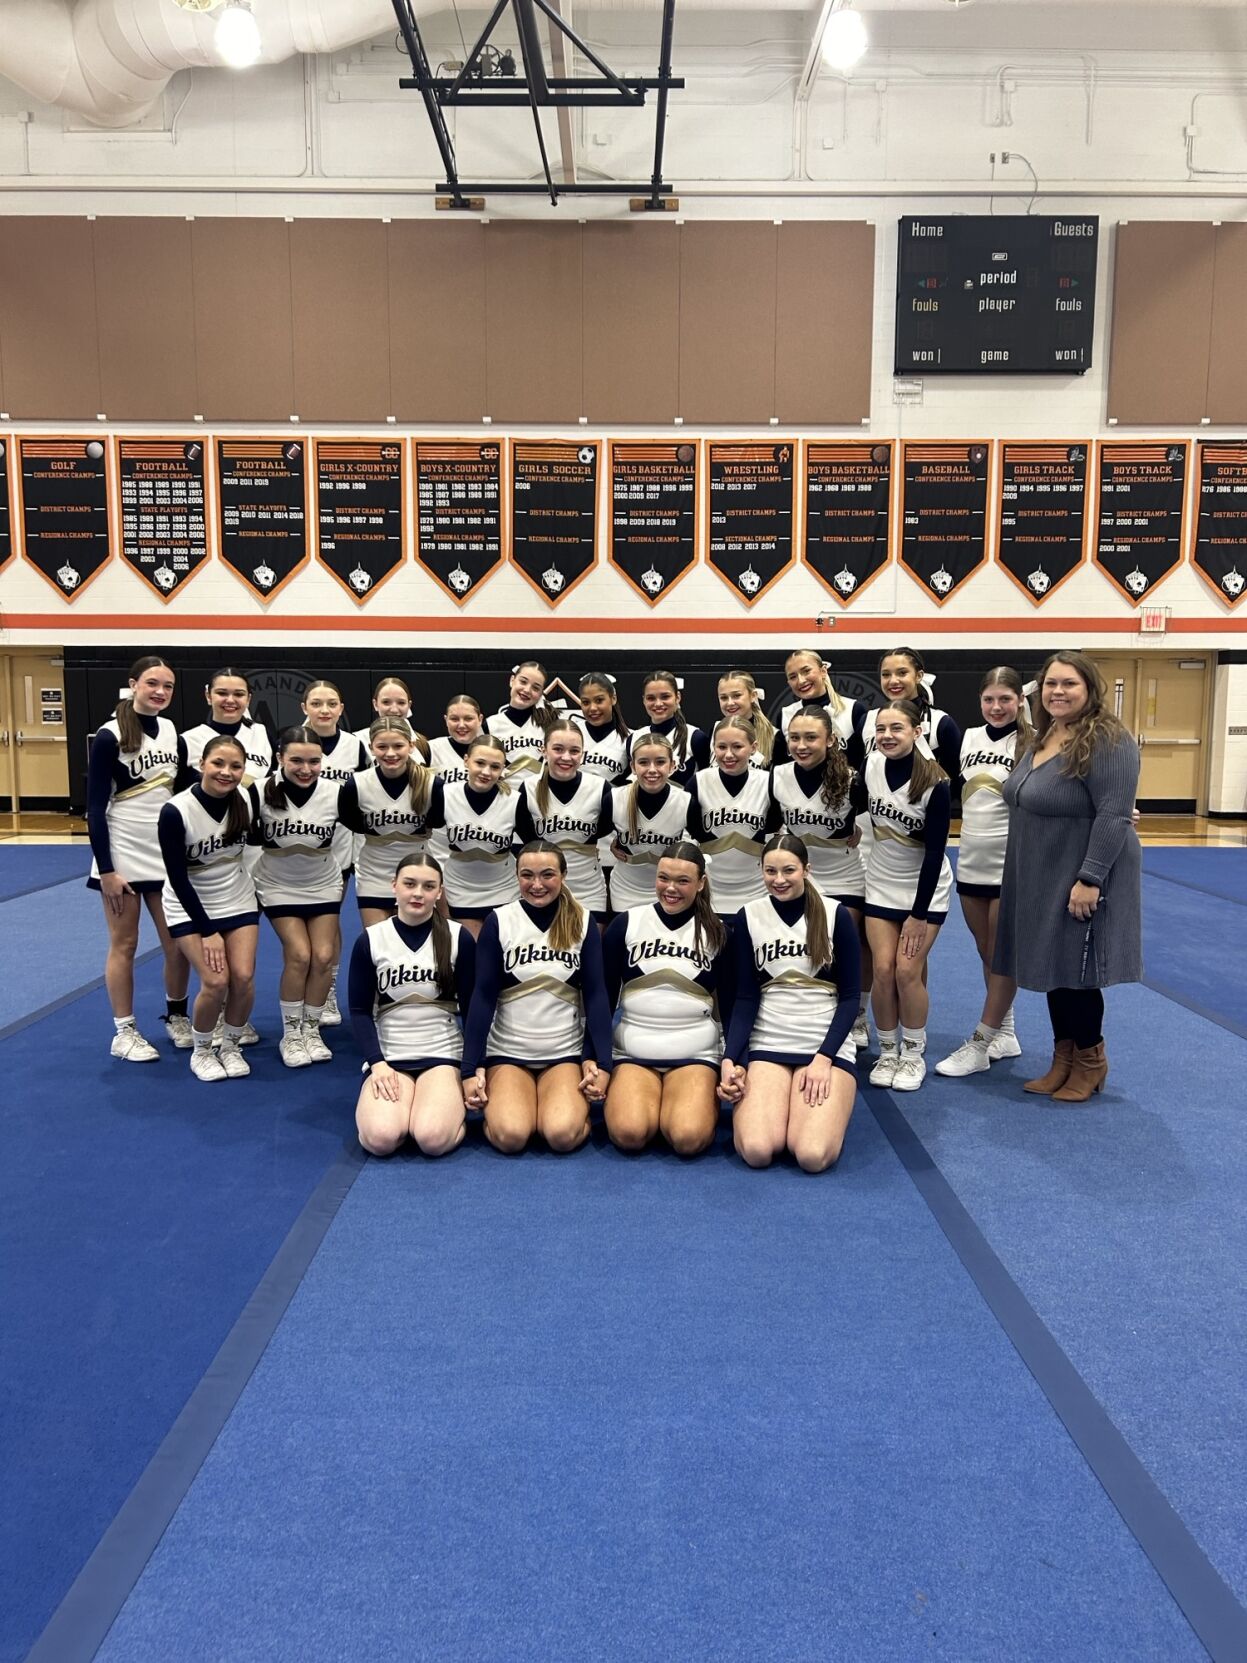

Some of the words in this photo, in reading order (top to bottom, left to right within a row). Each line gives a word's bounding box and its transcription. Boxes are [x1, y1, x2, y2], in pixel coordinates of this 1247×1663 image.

[912, 222, 943, 236] Home
[1054, 222, 1094, 236] Guests
[980, 270, 1017, 286] period
[912, 298, 938, 311] fouls
[979, 297, 1016, 312] player
[1056, 298, 1082, 311] fouls
[913, 351, 934, 361] won
[981, 349, 1009, 364] game
[1056, 349, 1077, 360] won
[519, 465, 548, 473] GIRLS
[553, 466, 591, 474] SOCCER
[536, 815, 598, 836] Vikings
[702, 808, 766, 833] Vikings
[264, 820, 332, 840] Vikings
[449, 824, 513, 847] Vikings
[504, 943, 580, 973] Vikings
[629, 939, 711, 970] Vikings
